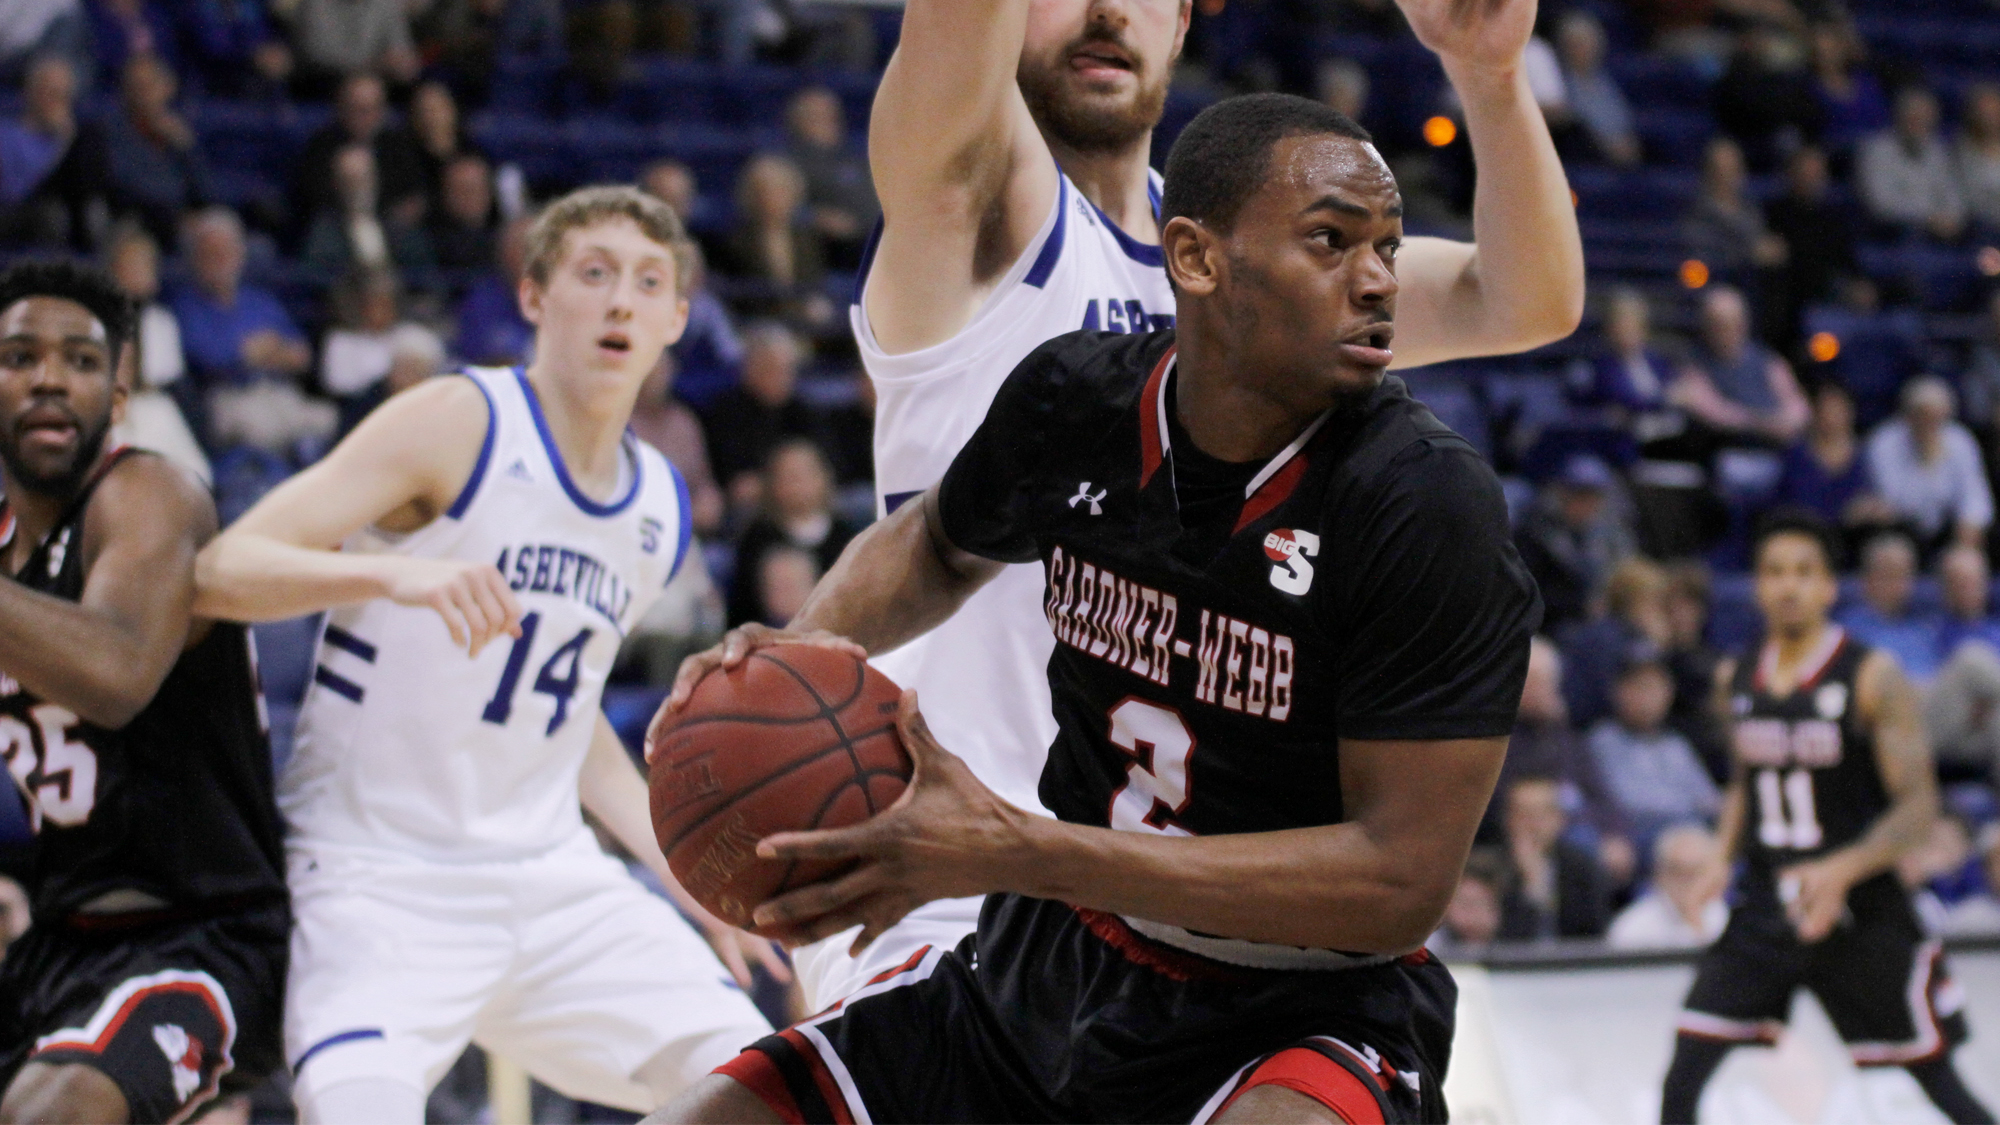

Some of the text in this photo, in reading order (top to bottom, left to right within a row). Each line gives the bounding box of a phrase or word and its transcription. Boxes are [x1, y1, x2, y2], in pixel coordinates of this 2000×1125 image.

[481, 611, 594, 736] 14
[1047, 545, 1295, 722] GARDNER-WEBB
[1107, 697, 1196, 837] 2
[1757, 768, 1823, 849] 11
